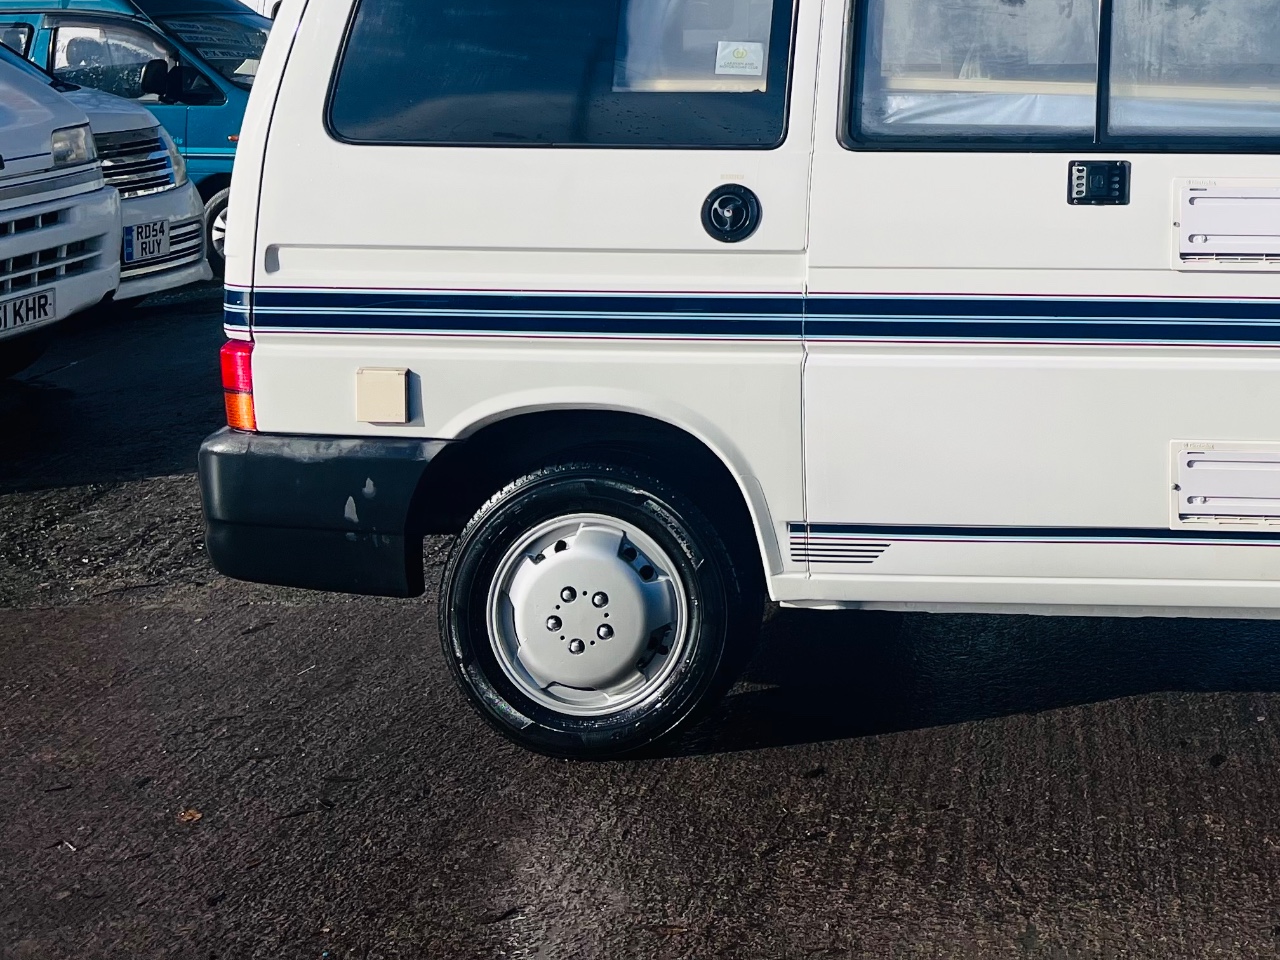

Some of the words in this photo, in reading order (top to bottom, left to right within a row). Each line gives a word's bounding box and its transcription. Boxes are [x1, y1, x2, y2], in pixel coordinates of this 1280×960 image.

[136, 221, 165, 241] RD54
[141, 239, 162, 256] RUY
[13, 294, 48, 326] KHR
